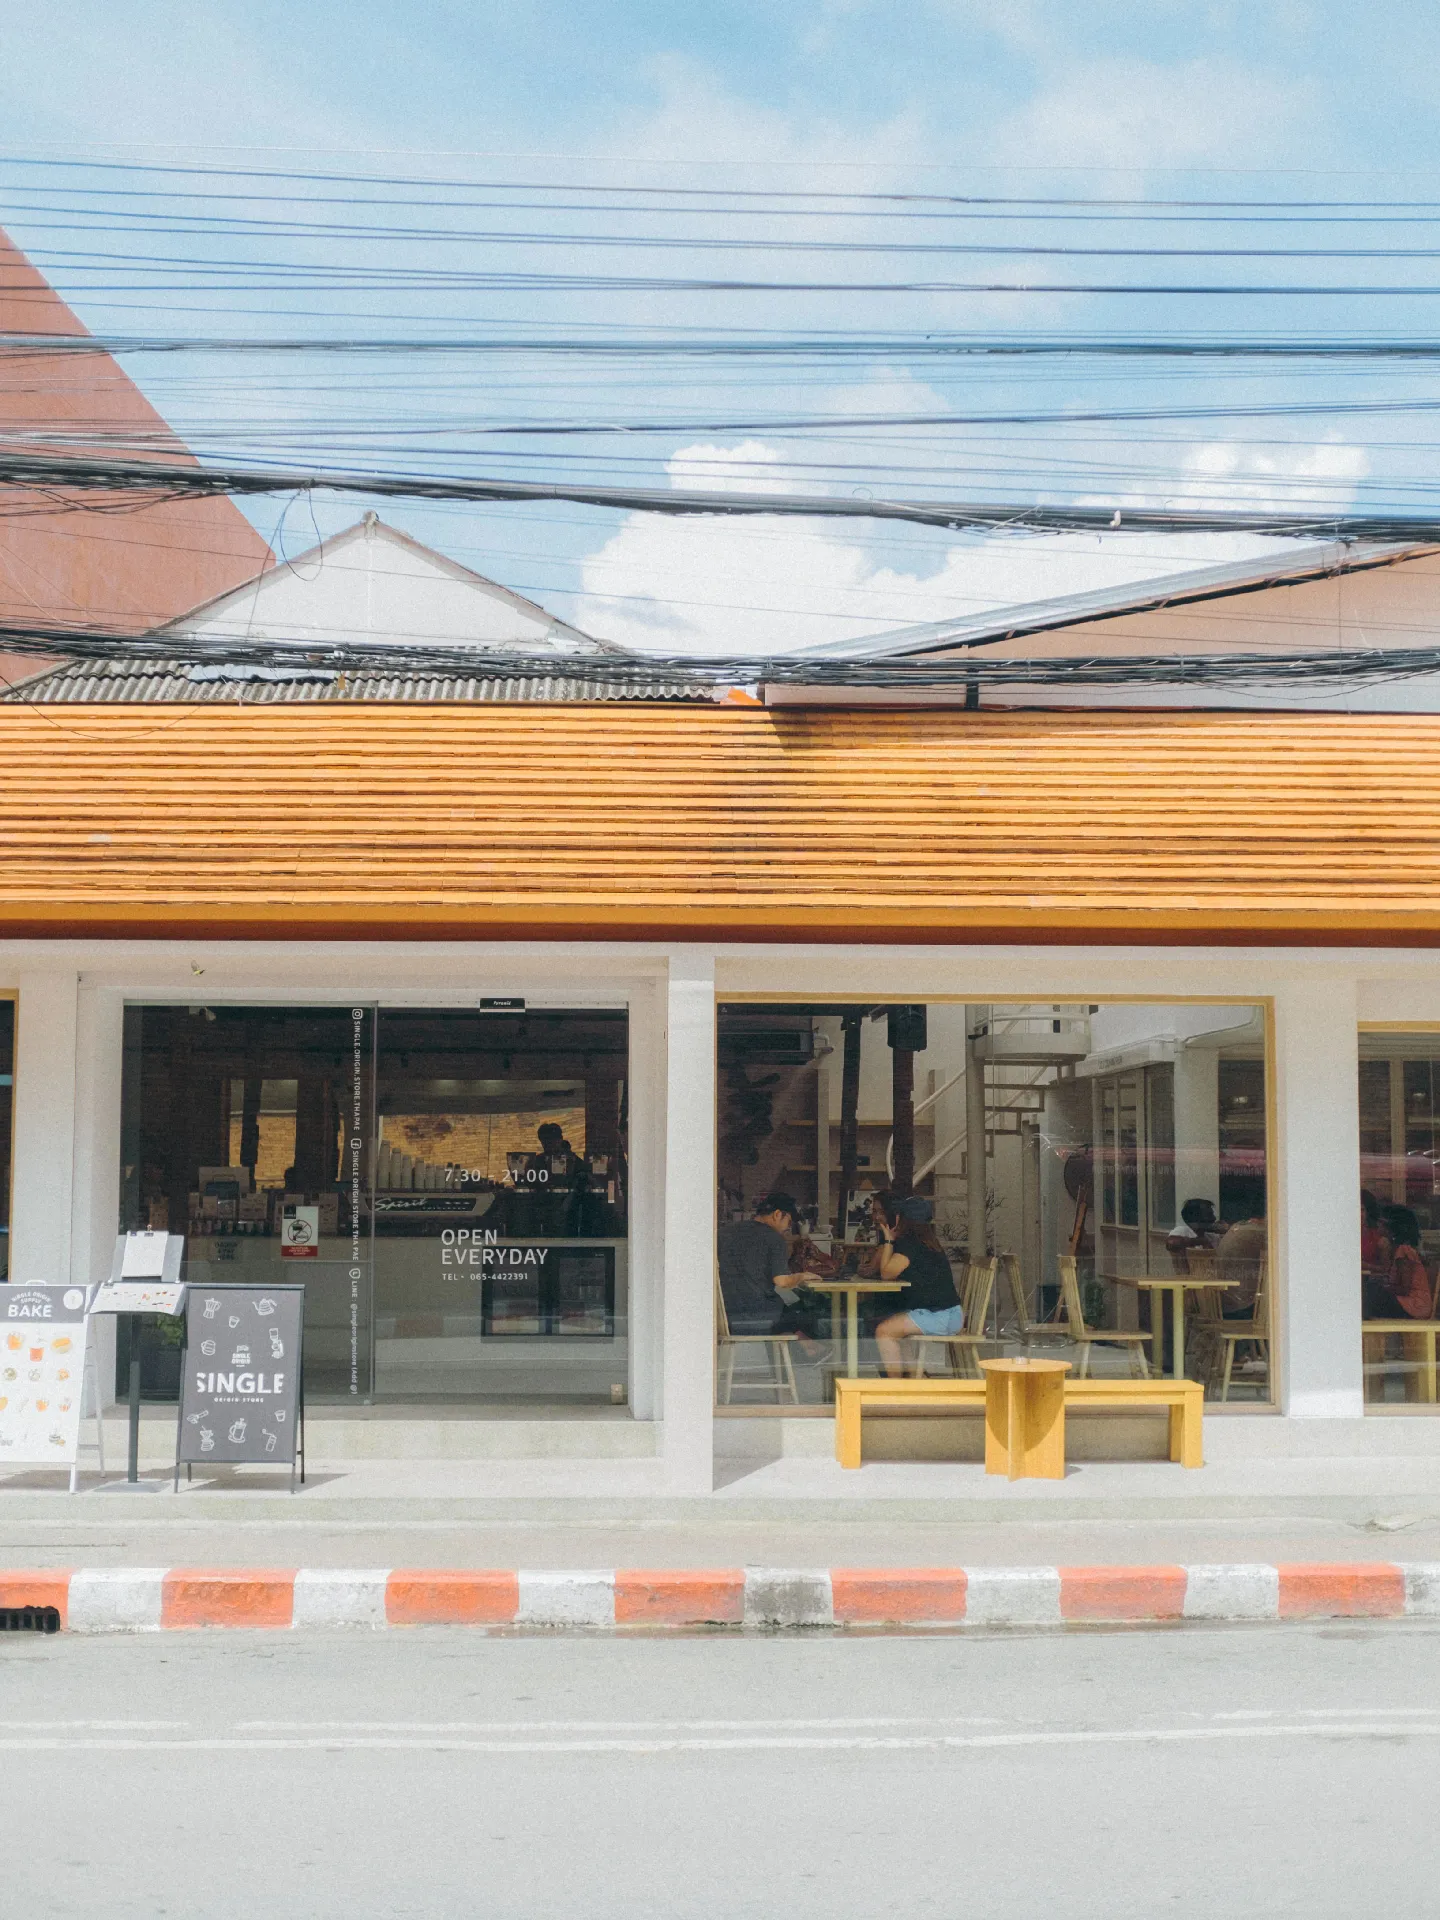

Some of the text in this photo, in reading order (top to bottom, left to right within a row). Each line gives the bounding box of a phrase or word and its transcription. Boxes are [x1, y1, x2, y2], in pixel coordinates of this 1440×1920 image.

[444, 1168, 481, 1182] 7.30
[501, 1169, 549, 1183] 21.00
[352, 1150, 360, 1261] SINGLE ORIGIN STORE THA PAE
[441, 1229, 498, 1246] OPEN
[441, 1248, 549, 1265] EVERYDAY
[470, 1272, 528, 1281] 065-4422391
[7, 1304, 53, 1317] BAKE
[196, 1372, 285, 1394] SINGLE
